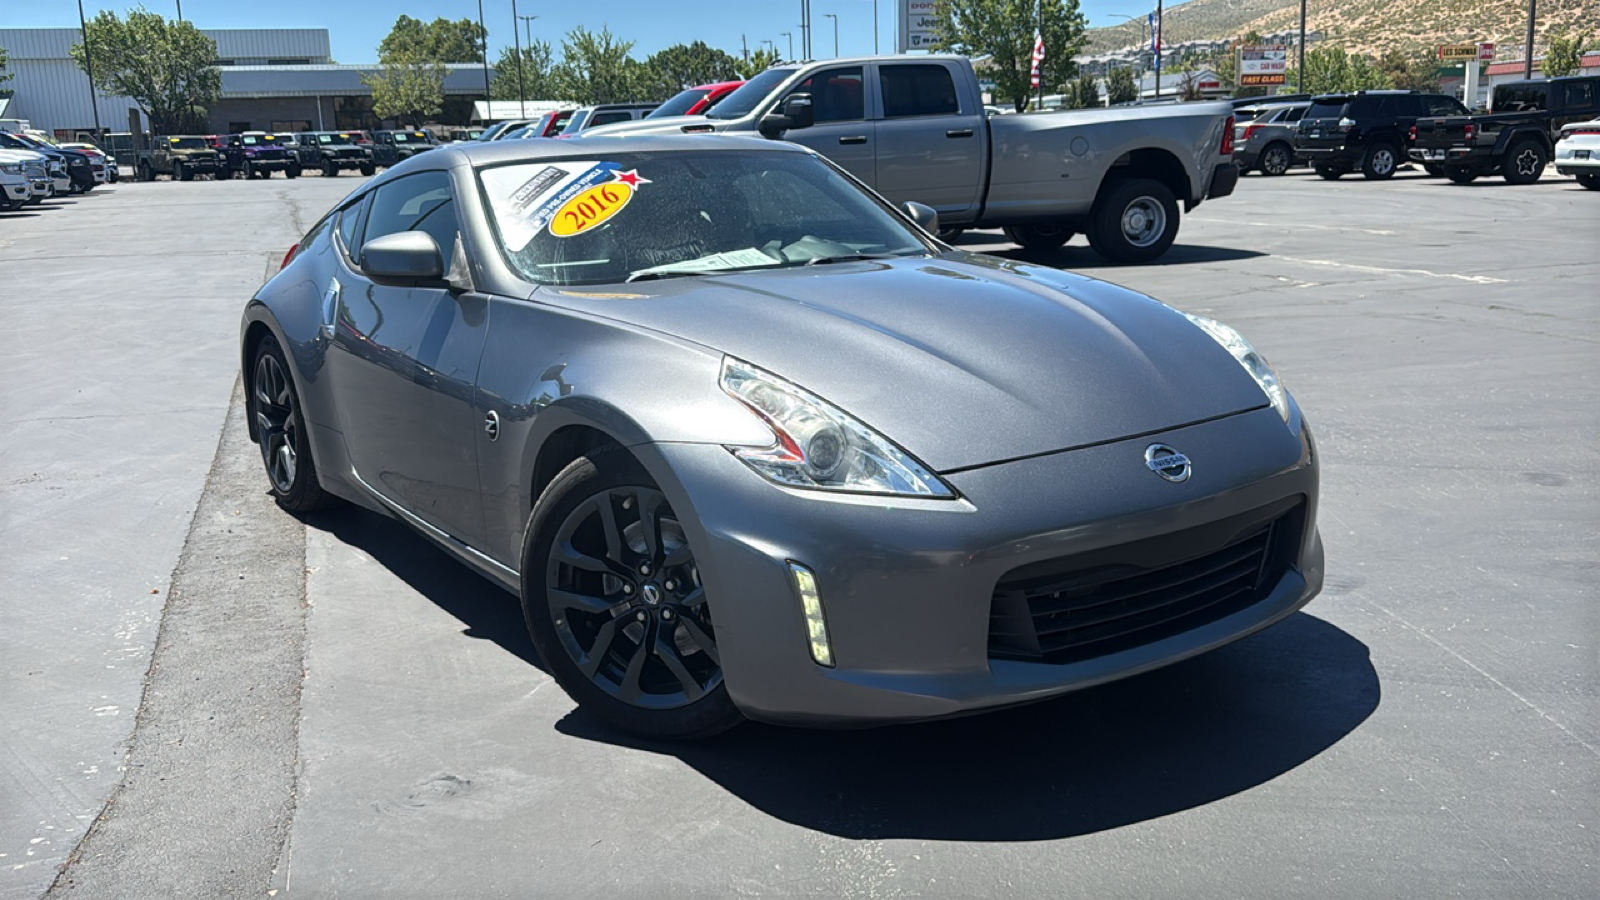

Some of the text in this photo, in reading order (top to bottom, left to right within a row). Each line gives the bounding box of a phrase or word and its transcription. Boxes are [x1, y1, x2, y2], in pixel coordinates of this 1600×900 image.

[1443, 48, 1453, 56] LES
[1243, 74, 1285, 84] FAST CLASS
[564, 186, 620, 231] 2016
[1153, 455, 1186, 467] NISSAN
